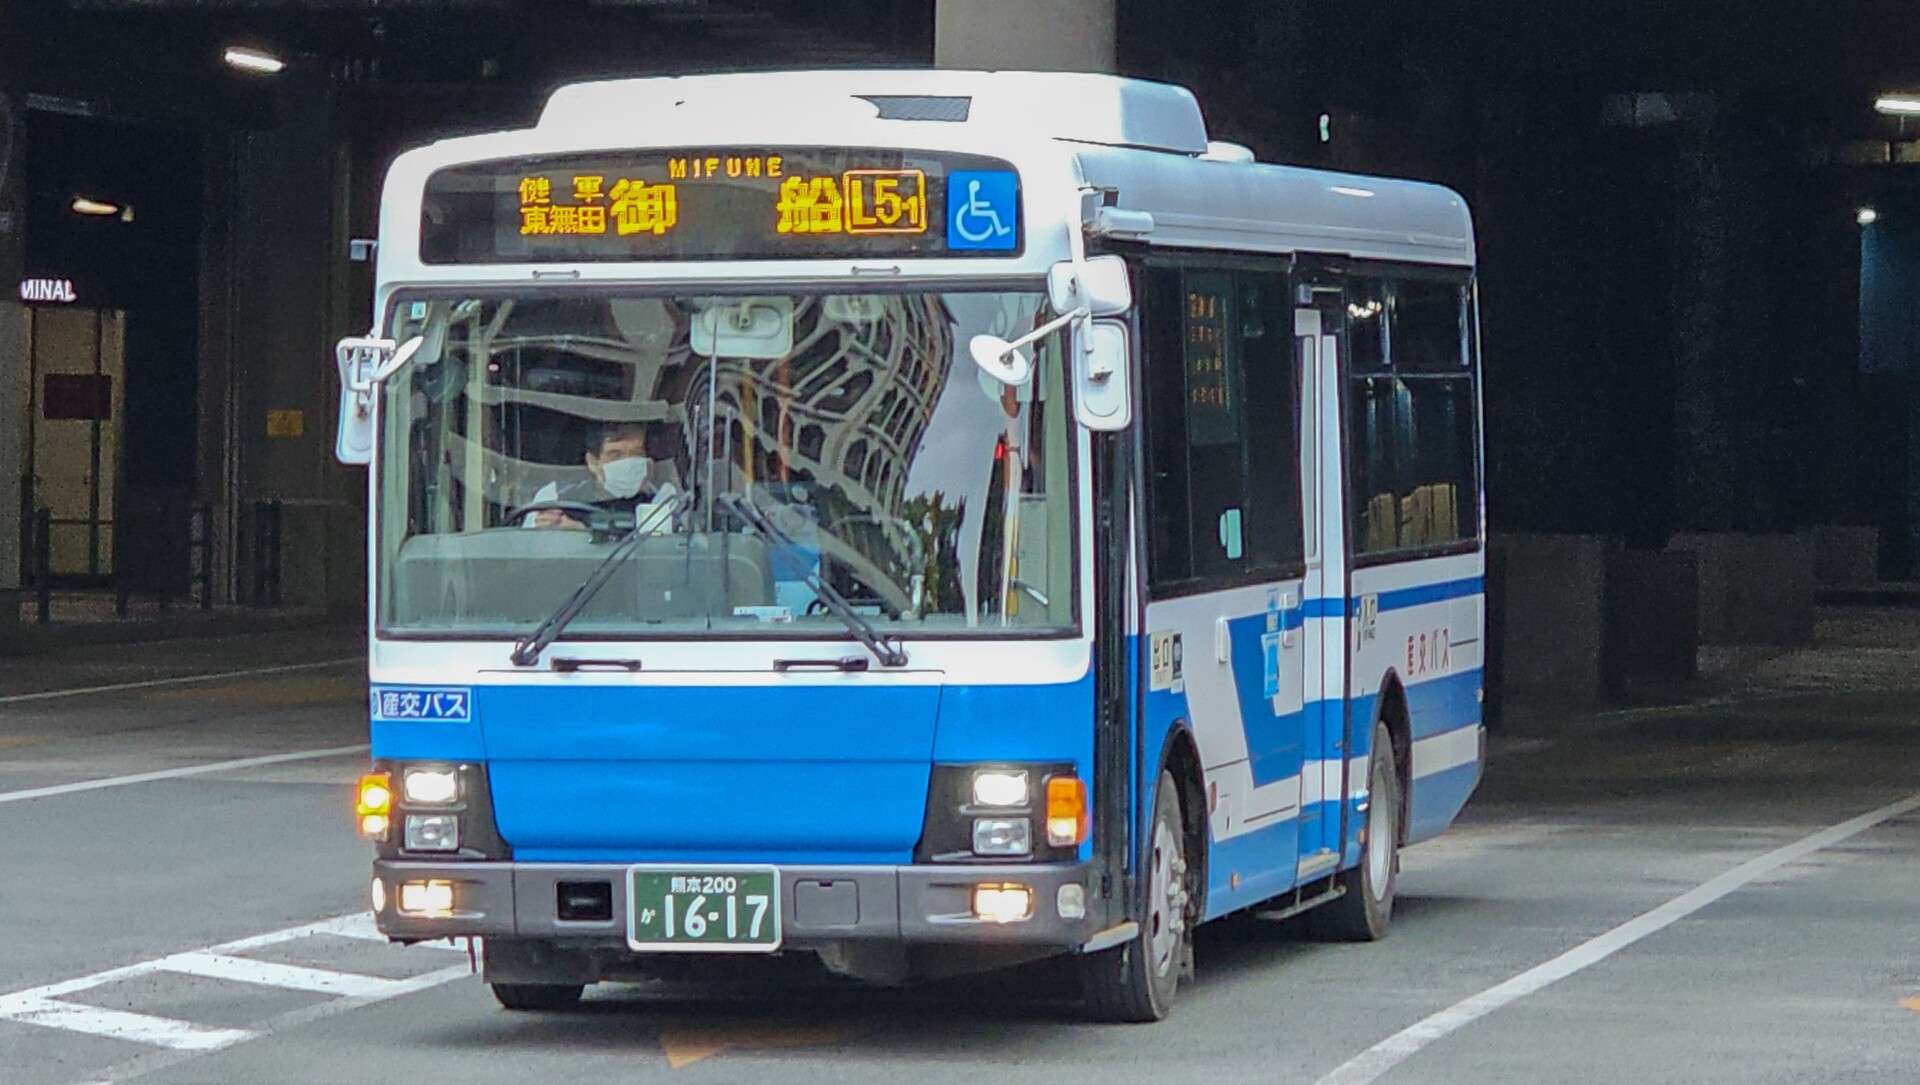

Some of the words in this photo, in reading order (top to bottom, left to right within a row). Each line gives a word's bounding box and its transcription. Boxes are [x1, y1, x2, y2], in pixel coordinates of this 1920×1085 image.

[669, 157, 783, 178] MIFUNE
[520, 205, 606, 235] 東無田
[383, 692, 466, 717] 産交バス
